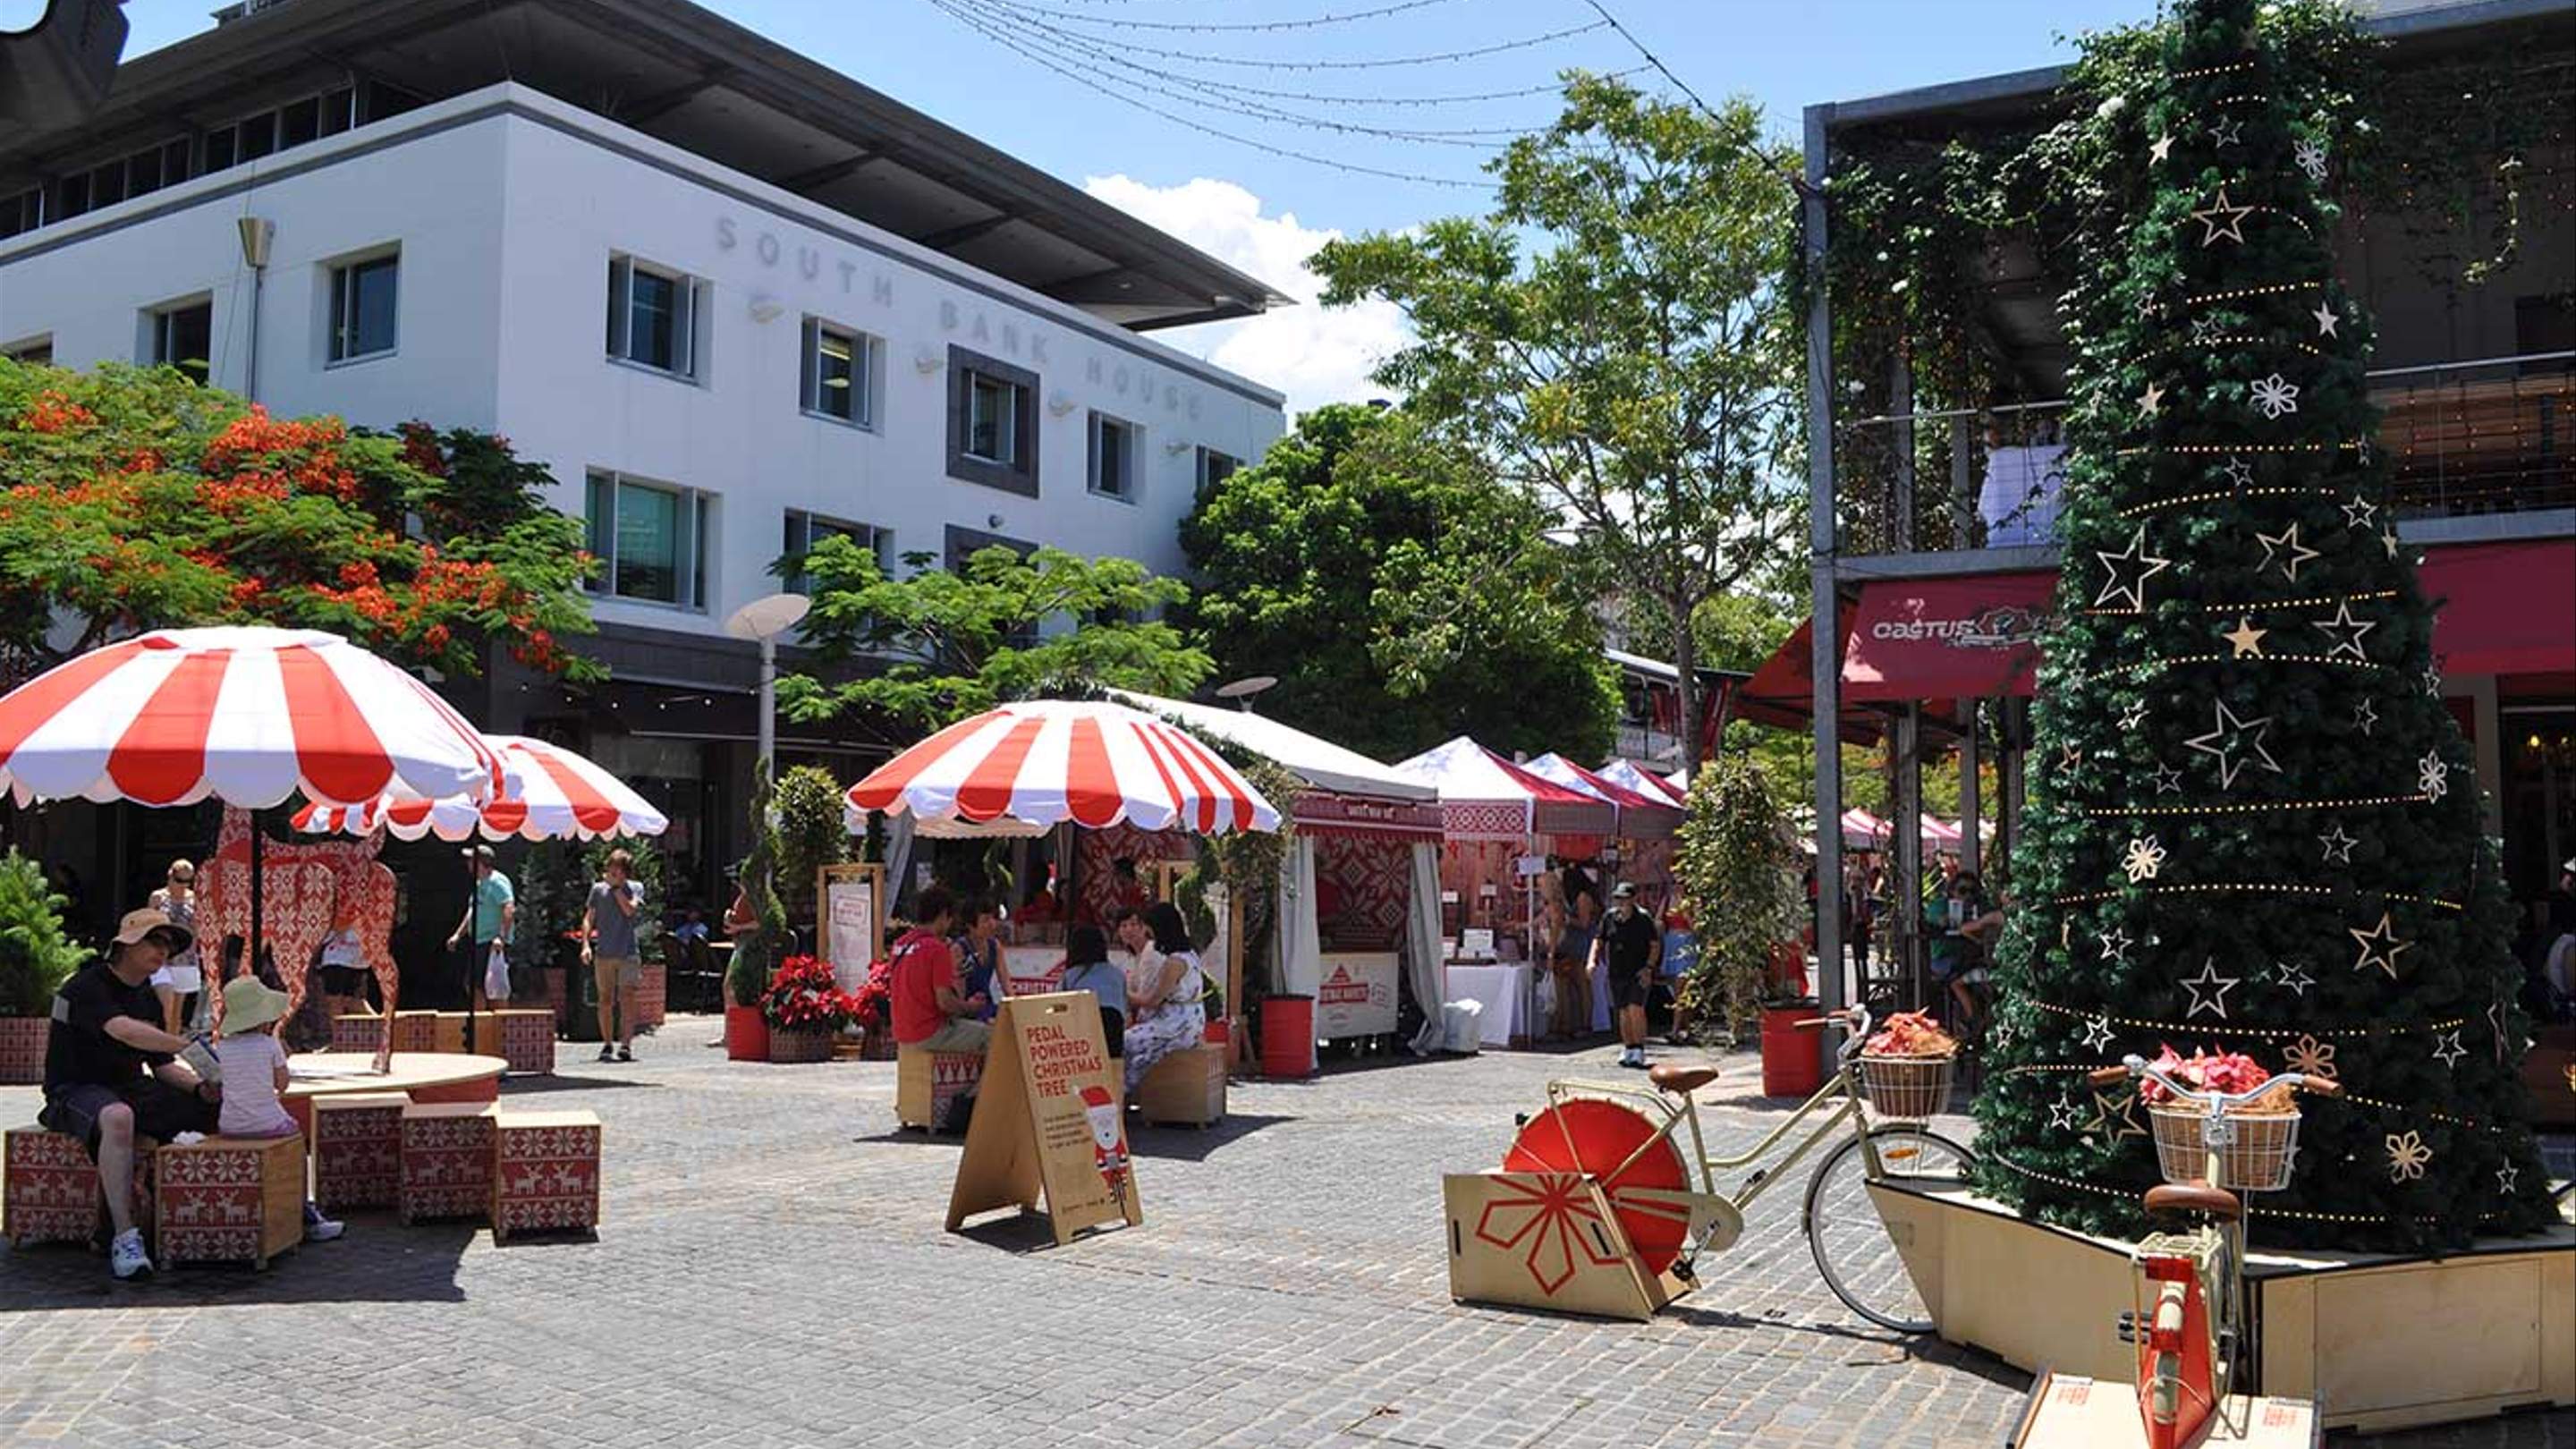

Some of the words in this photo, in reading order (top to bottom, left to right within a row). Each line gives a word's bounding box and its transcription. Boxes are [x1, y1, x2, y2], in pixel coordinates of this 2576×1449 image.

[716, 216, 894, 309] SOUTH
[940, 300, 1048, 364] BANK
[1087, 357, 1203, 420] HOUSE
[1026, 1022, 1065, 1043] PEDAL
[1030, 1038, 1090, 1063] POWERED
[1034, 1055, 1103, 1080] CHRISTMAS
[1036, 1079, 1069, 1098] TREE
